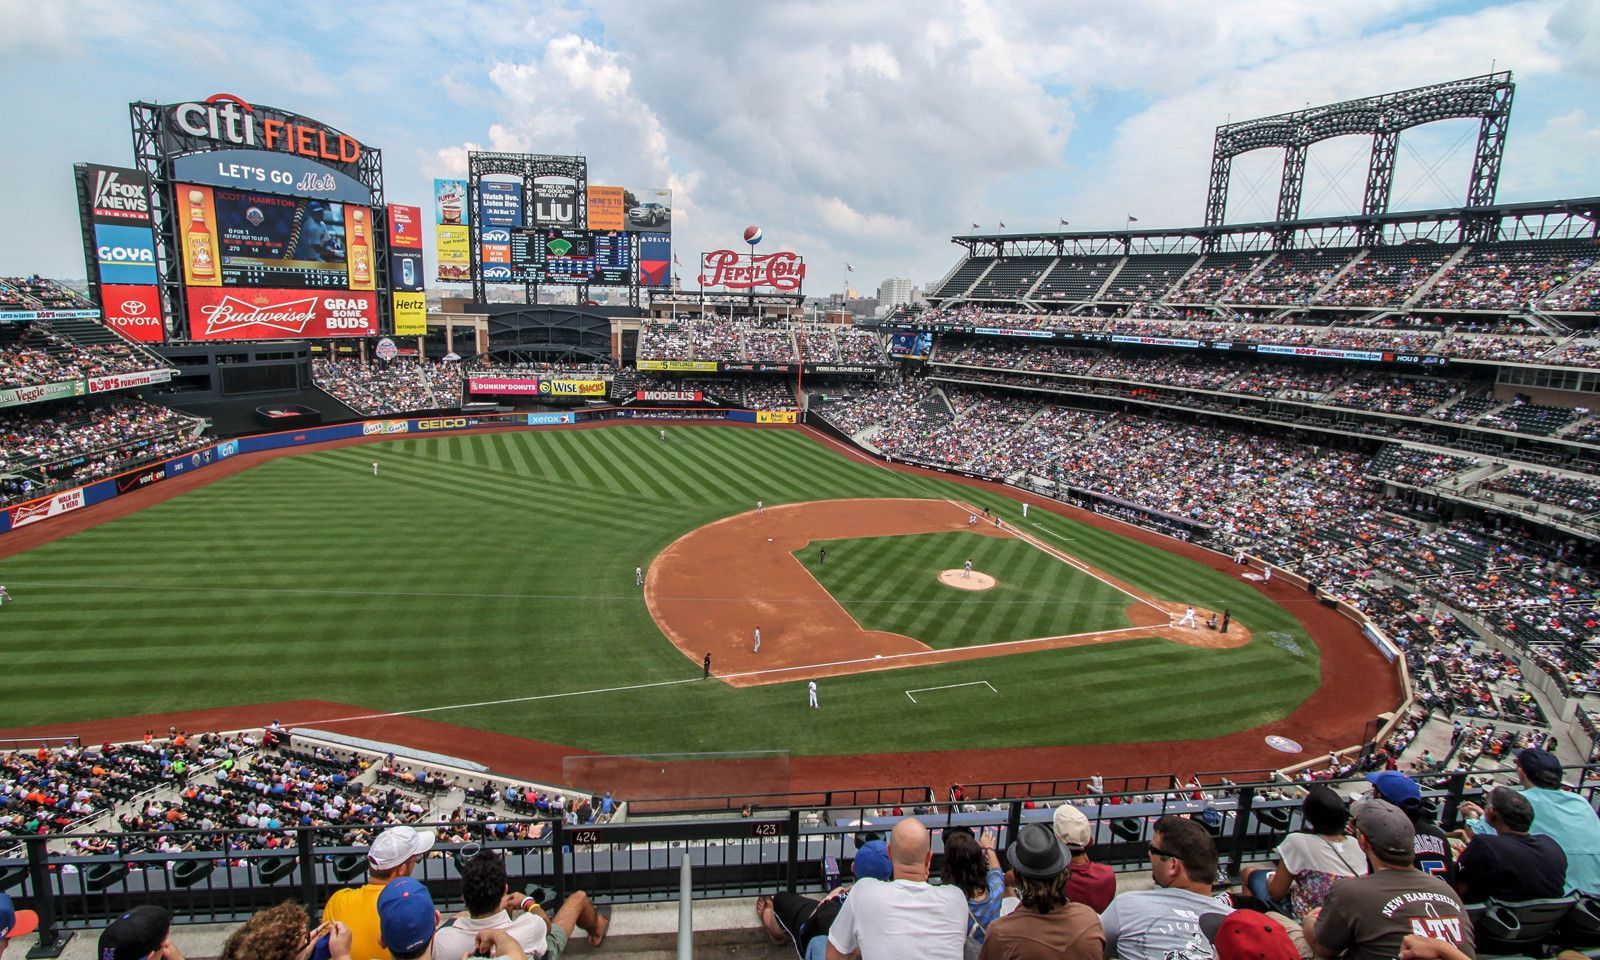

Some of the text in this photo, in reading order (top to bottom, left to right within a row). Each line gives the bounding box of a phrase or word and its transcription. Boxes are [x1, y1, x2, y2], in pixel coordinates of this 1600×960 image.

[264, 118, 361, 163] FIELD
[218, 162, 337, 191] LET'S GO Mets
[110, 182, 146, 199] FOX
[218, 192, 295, 207] SCOTT HAIRSTON
[483, 193, 504, 201] Watch
[101, 195, 148, 212] NEWS
[96, 210, 149, 219] channel
[482, 232, 508, 241] SNY
[98, 246, 154, 262] GOYA
[483, 268, 509, 278] SNY
[323, 298, 368, 310] GRAB
[396, 300, 424, 309] Hertz
[201, 304, 316, 324] Budweiser
[332, 310, 362, 318] SOME
[109, 316, 160, 326] TOYOTA
[325, 317, 369, 329] BUDS
[1295, 348, 1317, 356] BOB'S
[90, 378, 120, 393] BOB'S
[120, 376, 150, 387] FURNITURE
[508, 383, 536, 391] DONUTS
[16, 386, 44, 403] Veggie
[644, 391, 695, 401] MODELL'S
[417, 419, 467, 430] GEICO
[532, 416, 559, 424] xerox
[139, 470, 165, 485] verizon
[58, 491, 81, 504] WALK-OFF
[66, 499, 79, 508] HERO
[755, 824, 777, 835] 423
[575, 831, 598, 843] 424
[1382, 892, 1462, 918] NEW HAMPSHIRE
[1409, 916, 1466, 945] ATV
